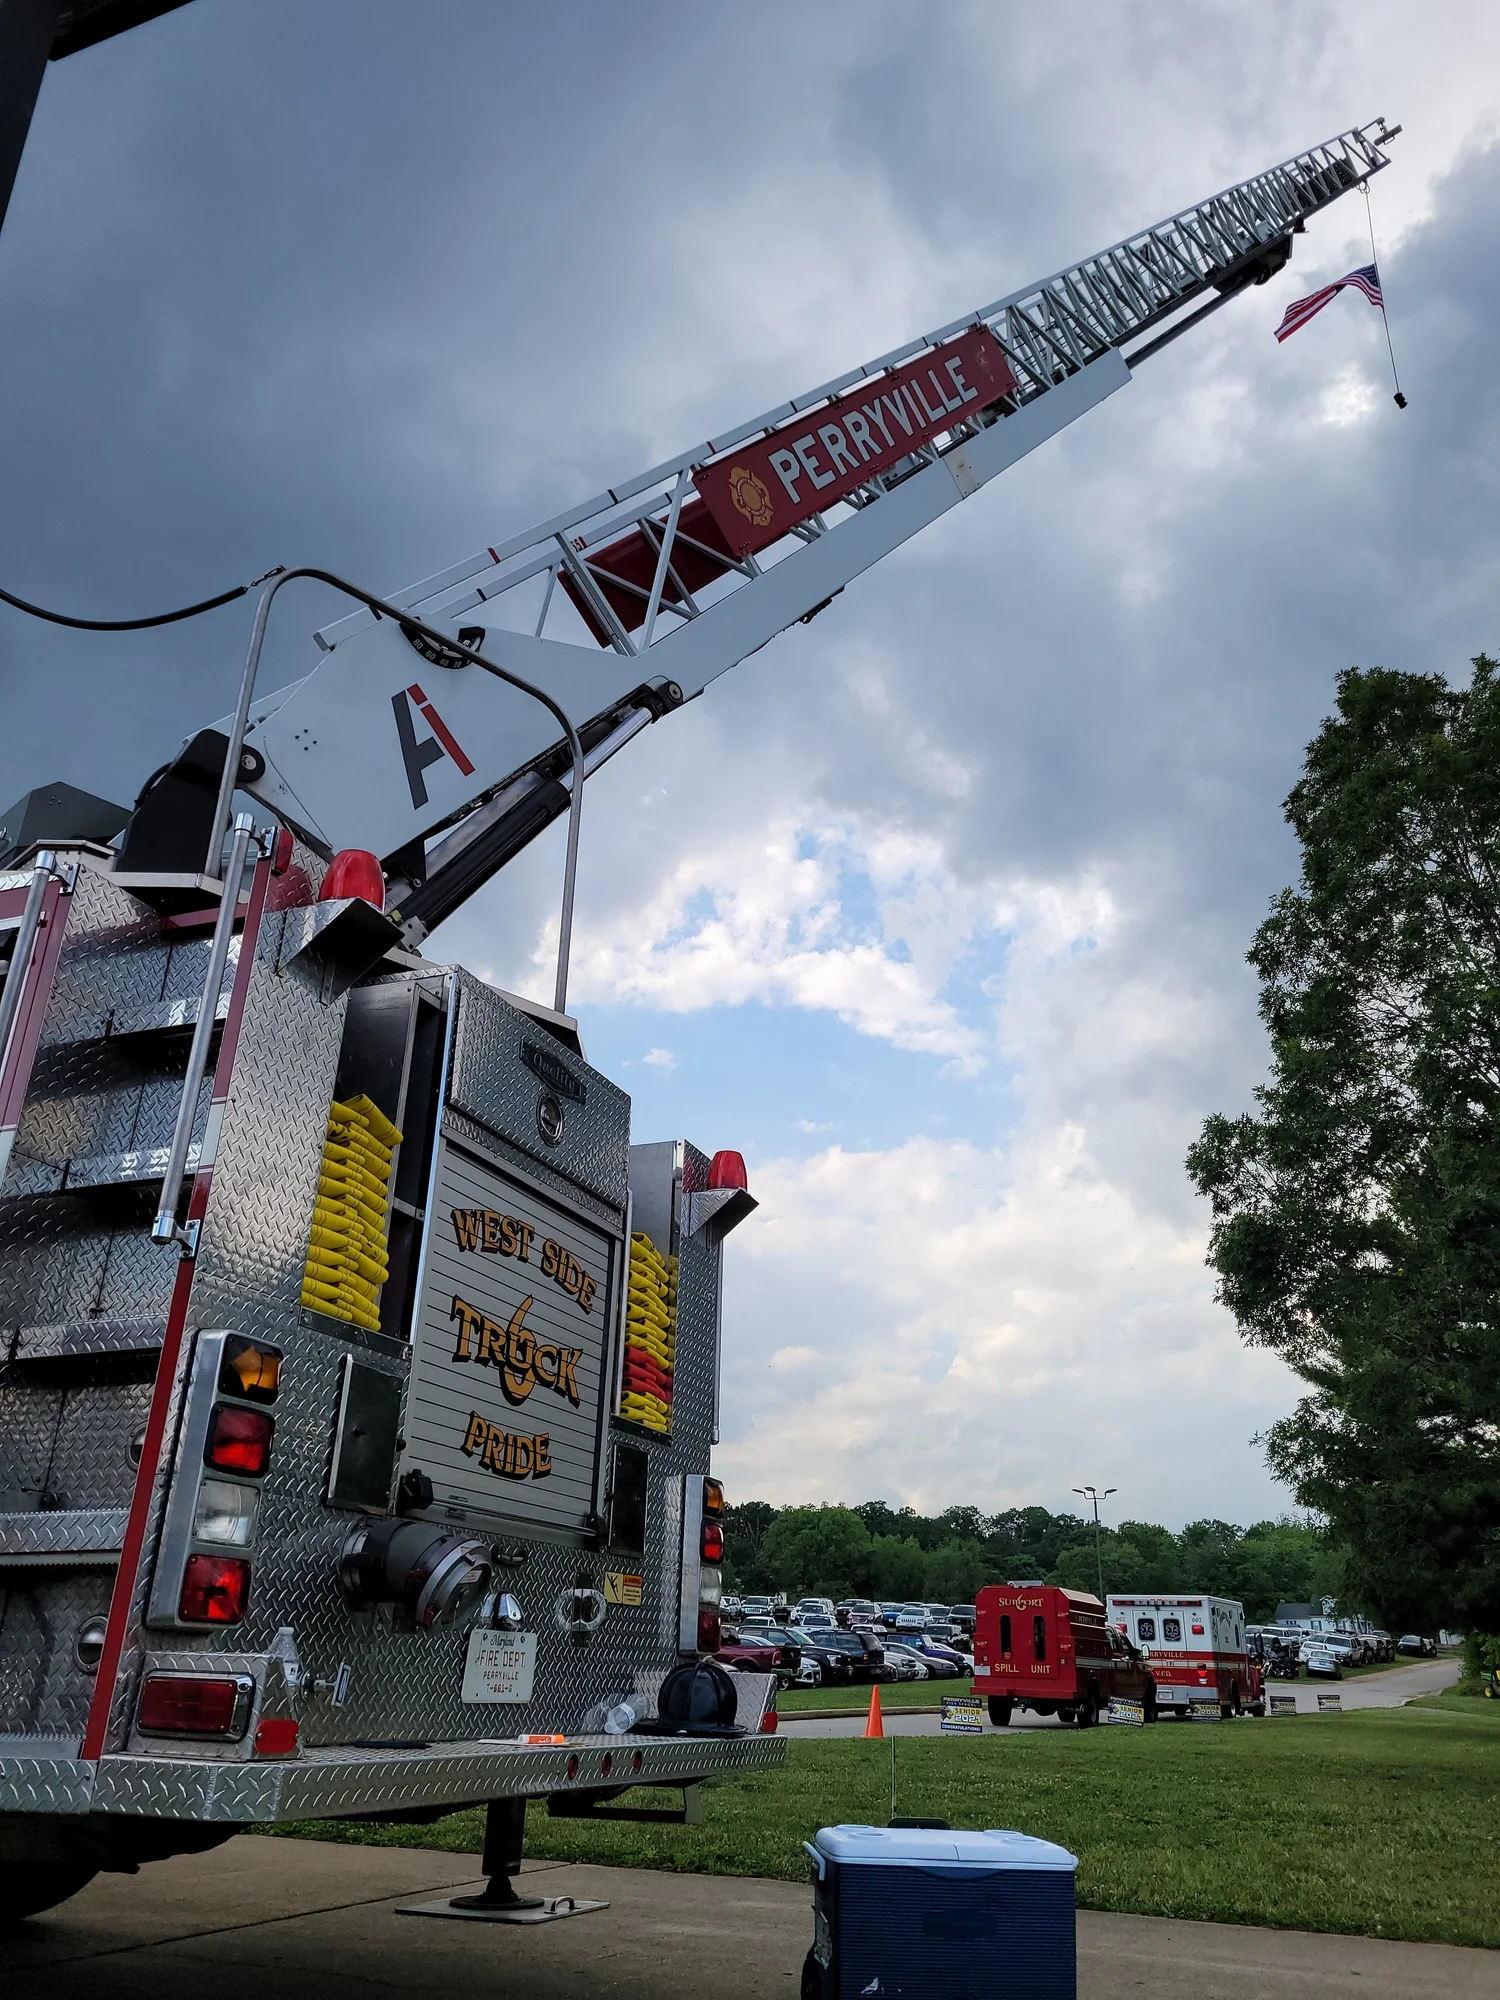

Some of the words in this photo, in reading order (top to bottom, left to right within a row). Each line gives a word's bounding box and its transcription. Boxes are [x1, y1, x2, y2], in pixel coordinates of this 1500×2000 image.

[768, 355, 979, 504] PERRYVILLE
[425, 650, 436, 660] 60
[440, 659, 449, 667] 40
[450, 1208, 535, 1263] WEST
[541, 1238, 598, 1315] SIDE
[450, 1294, 583, 1409] TRUCK
[460, 1411, 552, 1480] PRIDE
[490, 1634, 516, 1650] Maryland
[480, 1650, 499, 1667] FIRE
[503, 1651, 526, 1668] DEPT.
[483, 1671, 519, 1680] PERRYVILLE
[994, 1663, 1019, 1673] SPILL
[1031, 1664, 1051, 1674] UNIT
[943, 1696, 981, 1704] PERRYVILLE
[955, 1707, 981, 1715] SENIOR
[955, 1714, 981, 1724] 2021
[1120, 1711, 1142, 1720] 2021
